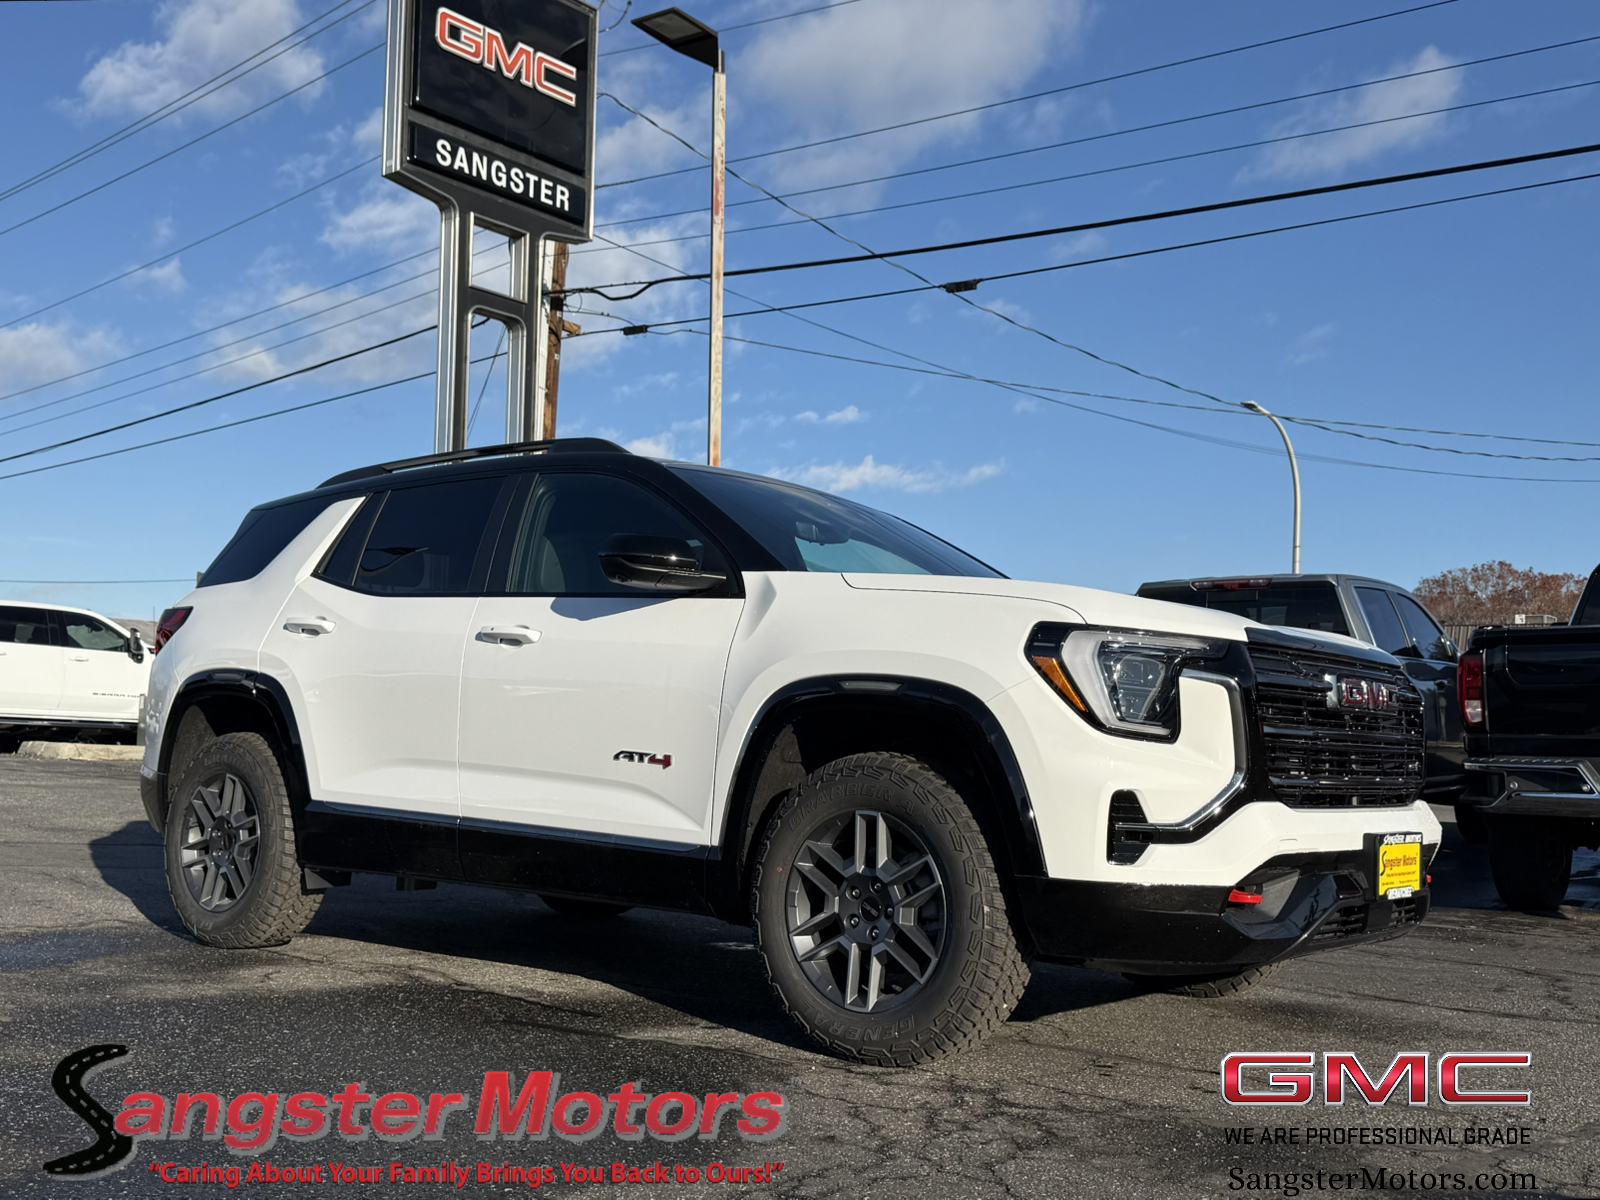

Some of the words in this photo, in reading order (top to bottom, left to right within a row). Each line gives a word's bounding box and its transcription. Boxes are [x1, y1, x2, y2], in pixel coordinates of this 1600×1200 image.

[435, 6, 578, 108] GMC
[435, 138, 571, 212] SANGSTER
[1340, 678, 1400, 710] GMC
[612, 749, 672, 770] AT4
[788, 782, 895, 832] GRABBER
[802, 997, 916, 1042] GENERAL
